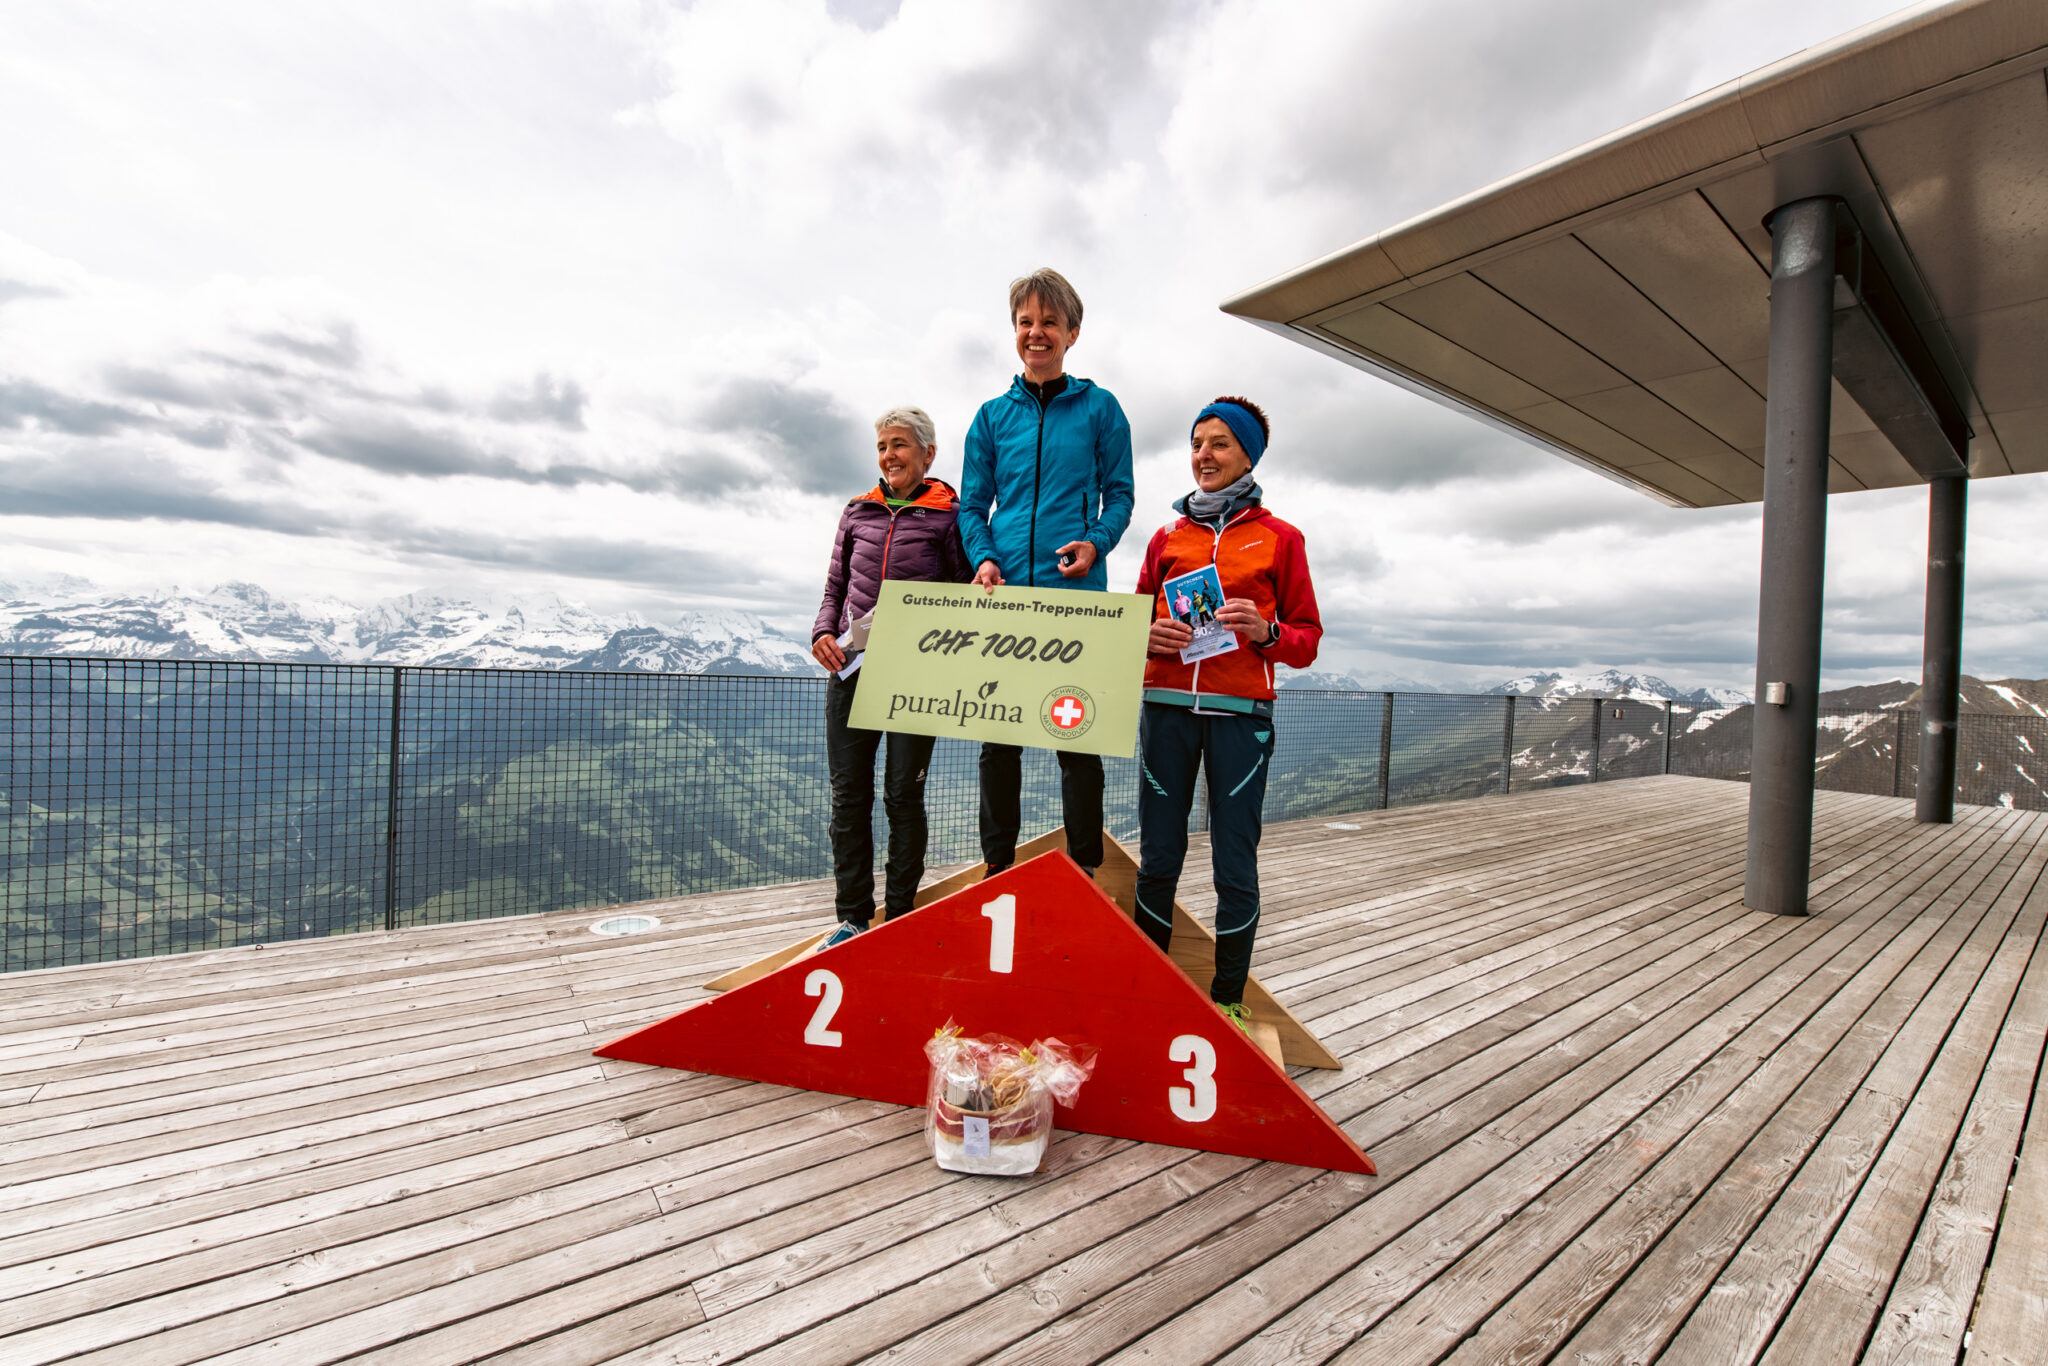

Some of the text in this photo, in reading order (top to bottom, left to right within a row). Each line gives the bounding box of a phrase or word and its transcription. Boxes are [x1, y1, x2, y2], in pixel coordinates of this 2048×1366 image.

[902, 593, 1124, 619] Gutschein Niesen-Treppenlauf
[918, 629, 1084, 663] CHF 100.00
[886, 681, 1024, 727] puralpina
[1051, 688, 1089, 702] SCHWEIZER
[1043, 714, 1092, 738] NATURPRODUKTE
[981, 893, 1016, 974] 1
[804, 969, 844, 1048] 2
[1168, 1034, 1217, 1122] 3
